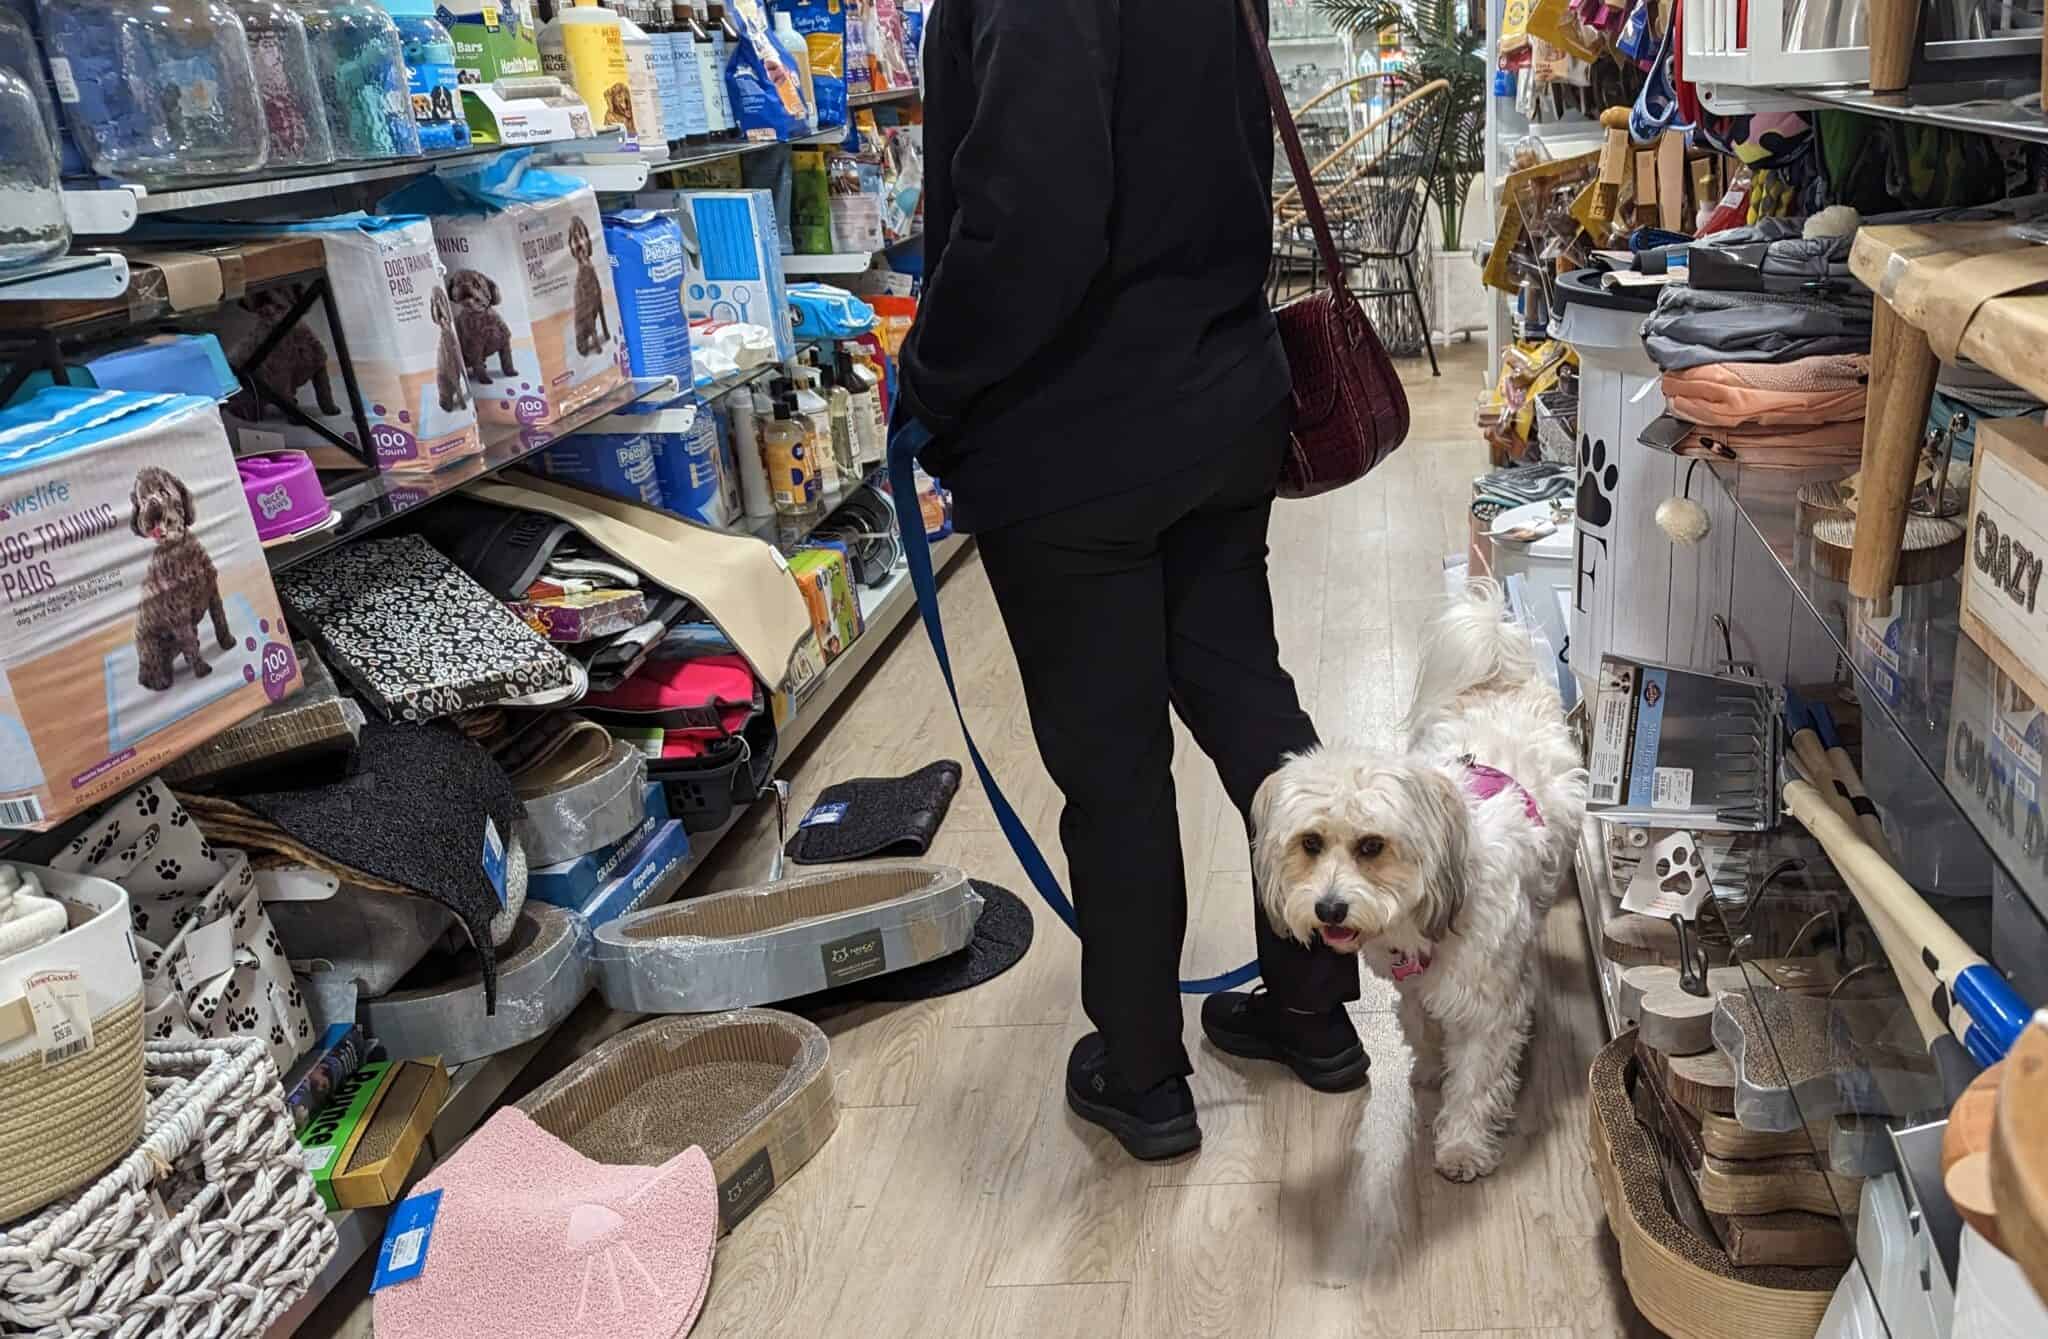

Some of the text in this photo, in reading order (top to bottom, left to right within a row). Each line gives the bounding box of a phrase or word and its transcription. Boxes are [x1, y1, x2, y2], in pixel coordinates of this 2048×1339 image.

[384, 259, 406, 278] DOG
[389, 278, 414, 296] PADS
[519, 401, 542, 412] 100
[372, 433, 406, 447] 100
[376, 447, 407, 456] Count
[34, 503, 118, 555] TRAINING
[1973, 509, 2044, 614] CRAZY
[2, 560, 57, 602] PADS
[264, 649, 289, 673] 100
